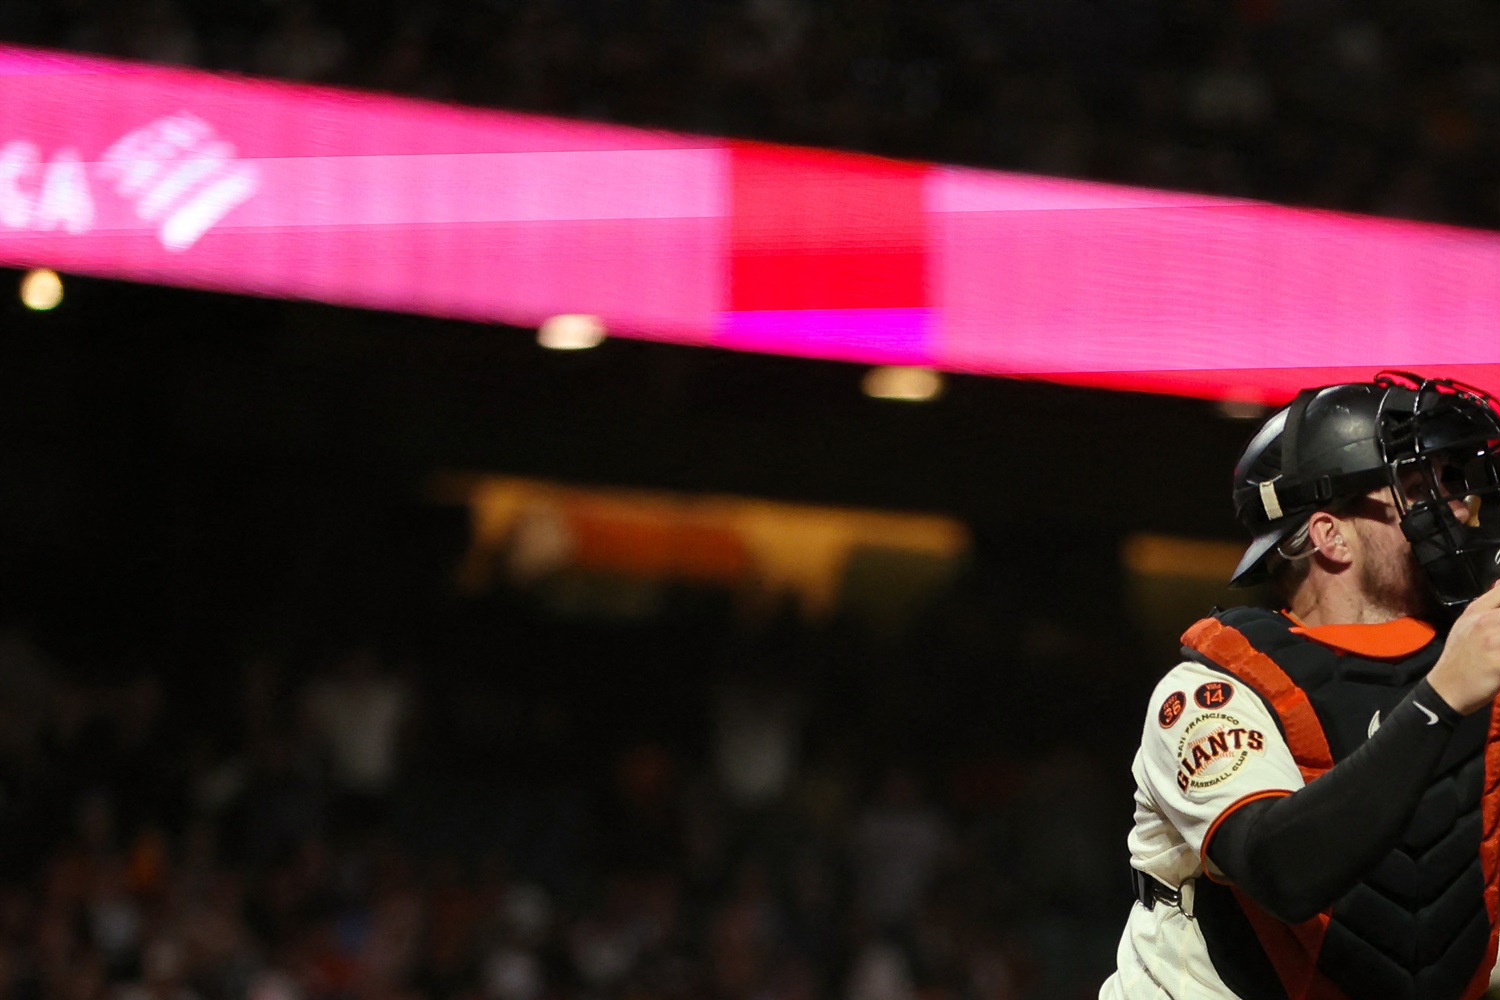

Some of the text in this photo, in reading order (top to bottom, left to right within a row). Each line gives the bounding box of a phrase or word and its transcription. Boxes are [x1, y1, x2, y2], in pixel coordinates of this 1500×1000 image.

[1163, 700, 1182, 723] 36
[1203, 689, 1224, 705] 14
[1177, 713, 1240, 758] SAN FRANCISCO
[1177, 728, 1264, 793] GIANTS
[1190, 750, 1248, 788] BASEBALL CLUB
